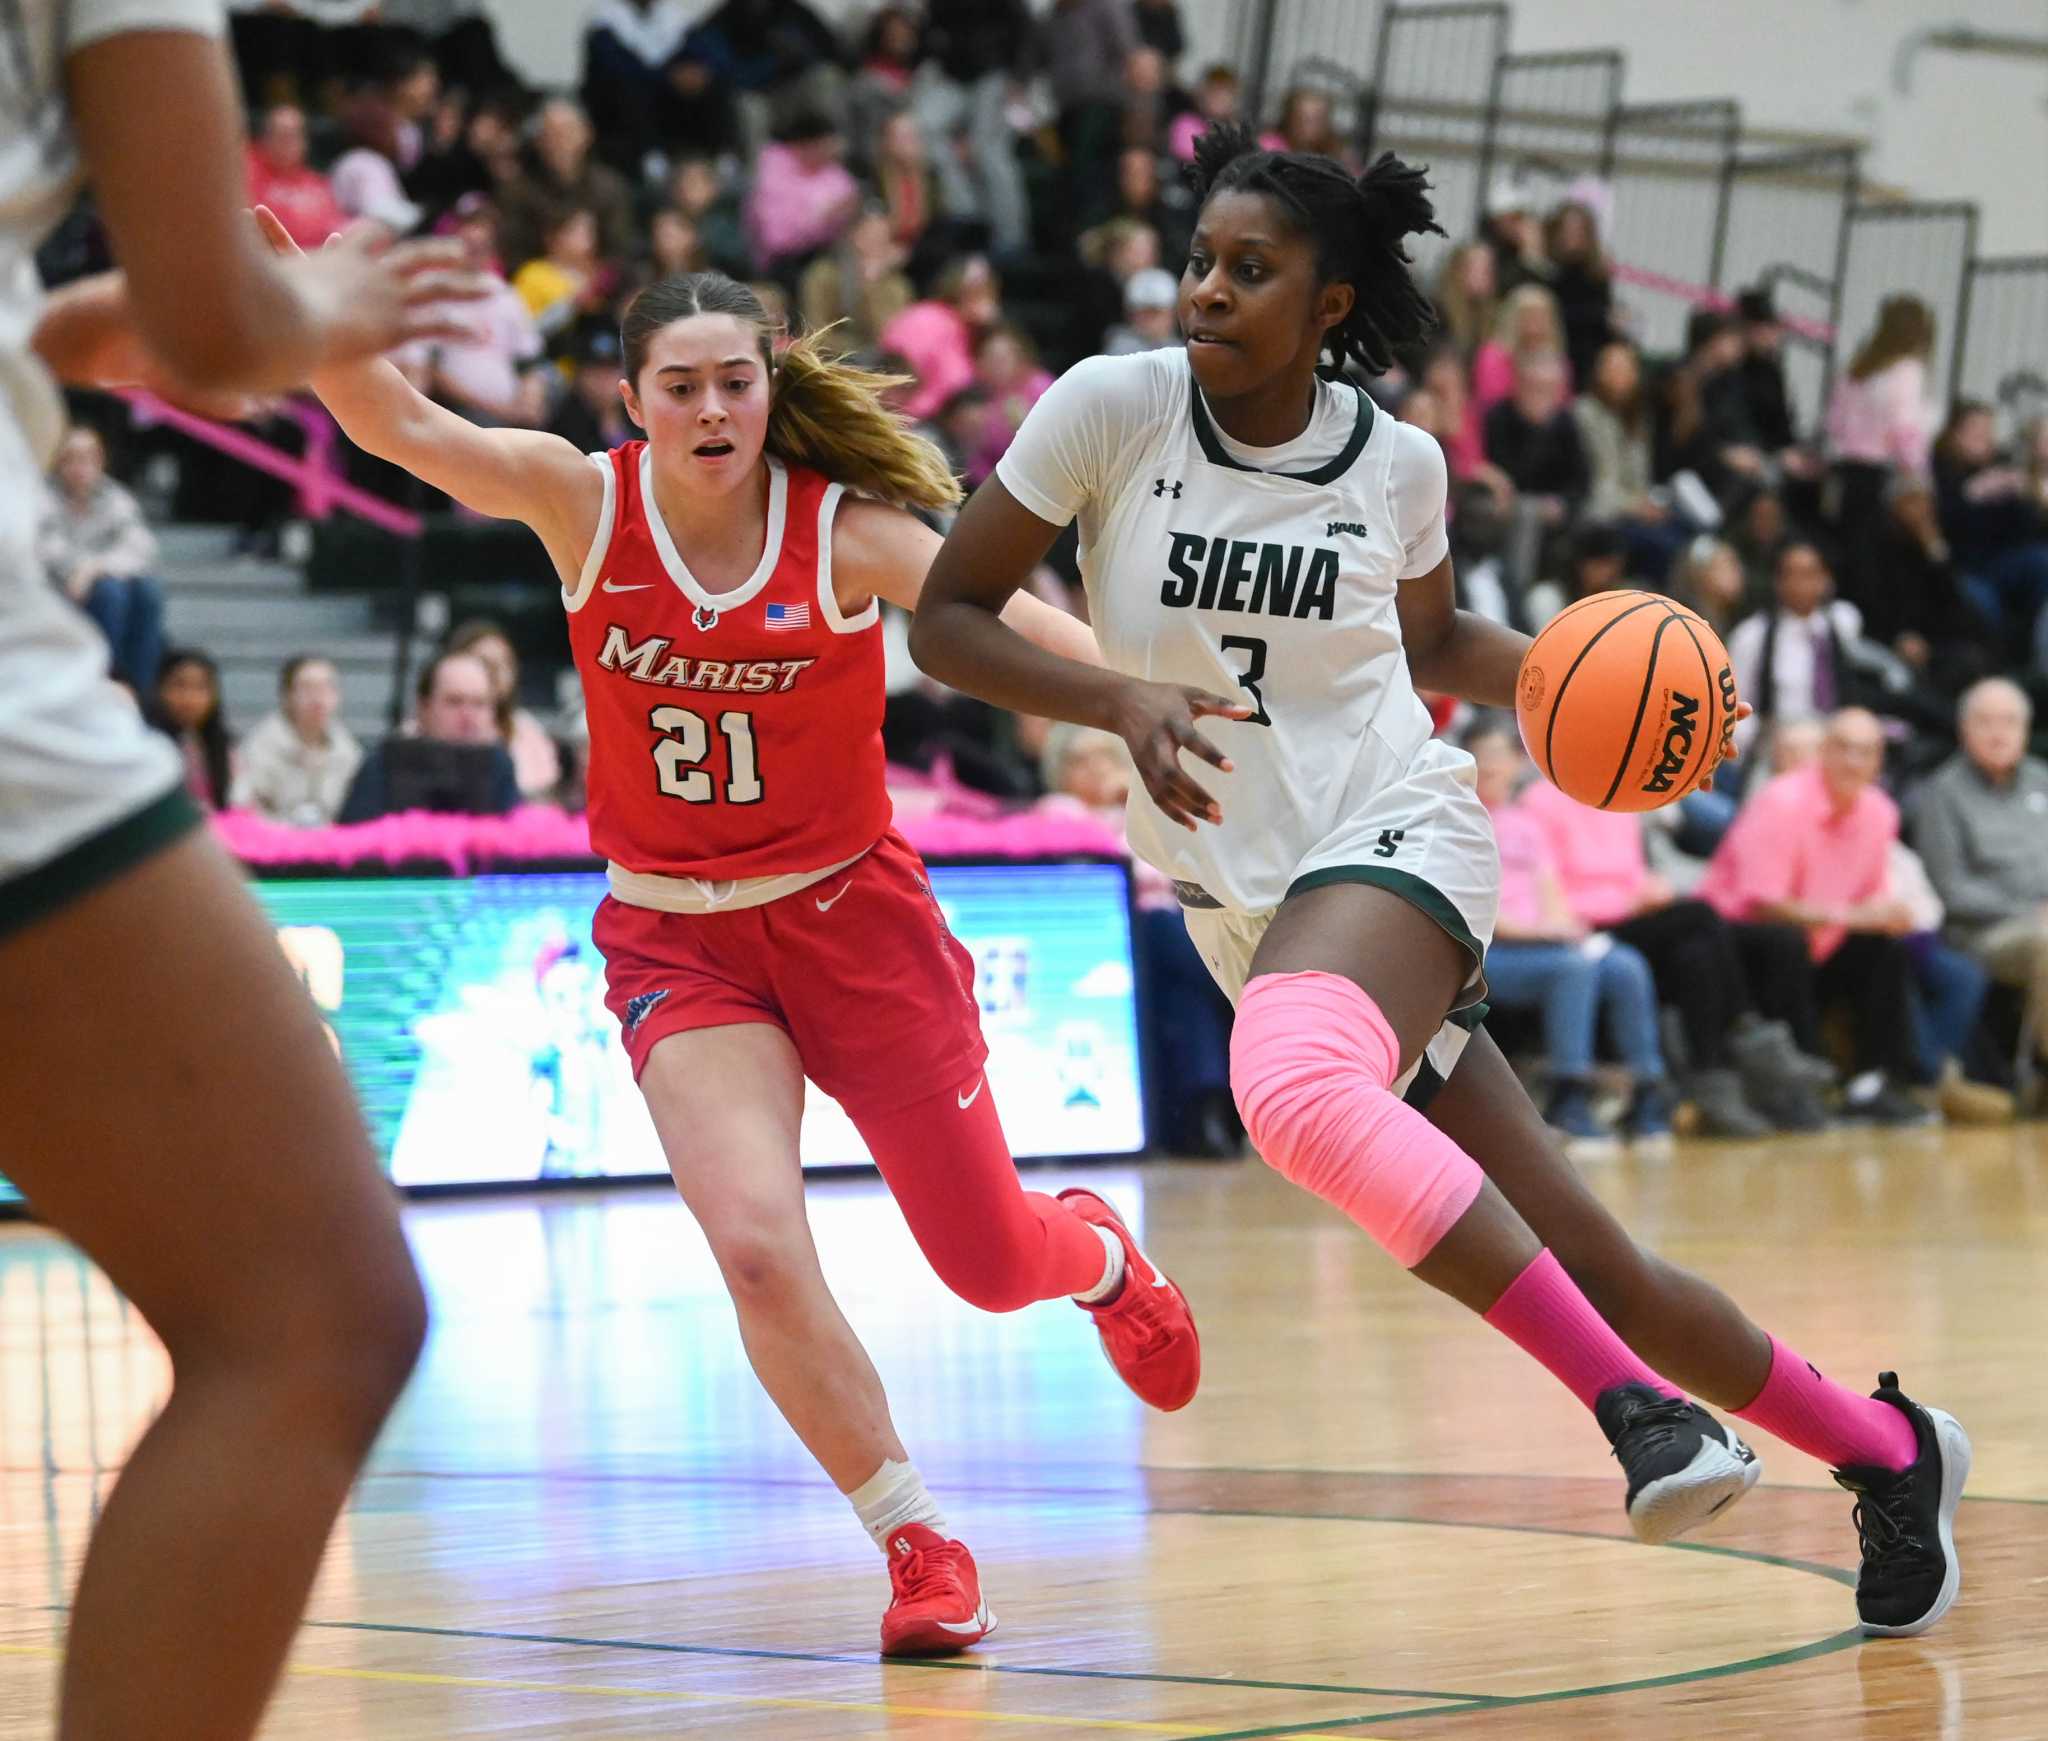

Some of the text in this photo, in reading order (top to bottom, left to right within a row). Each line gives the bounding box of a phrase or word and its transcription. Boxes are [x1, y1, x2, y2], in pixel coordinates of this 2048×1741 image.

[1160, 531, 1339, 620] SIENA
[1220, 635, 1271, 727] 3
[649, 704, 766, 805] 21
[1641, 690, 1699, 792] NCAA
[1373, 829, 1405, 858] S
